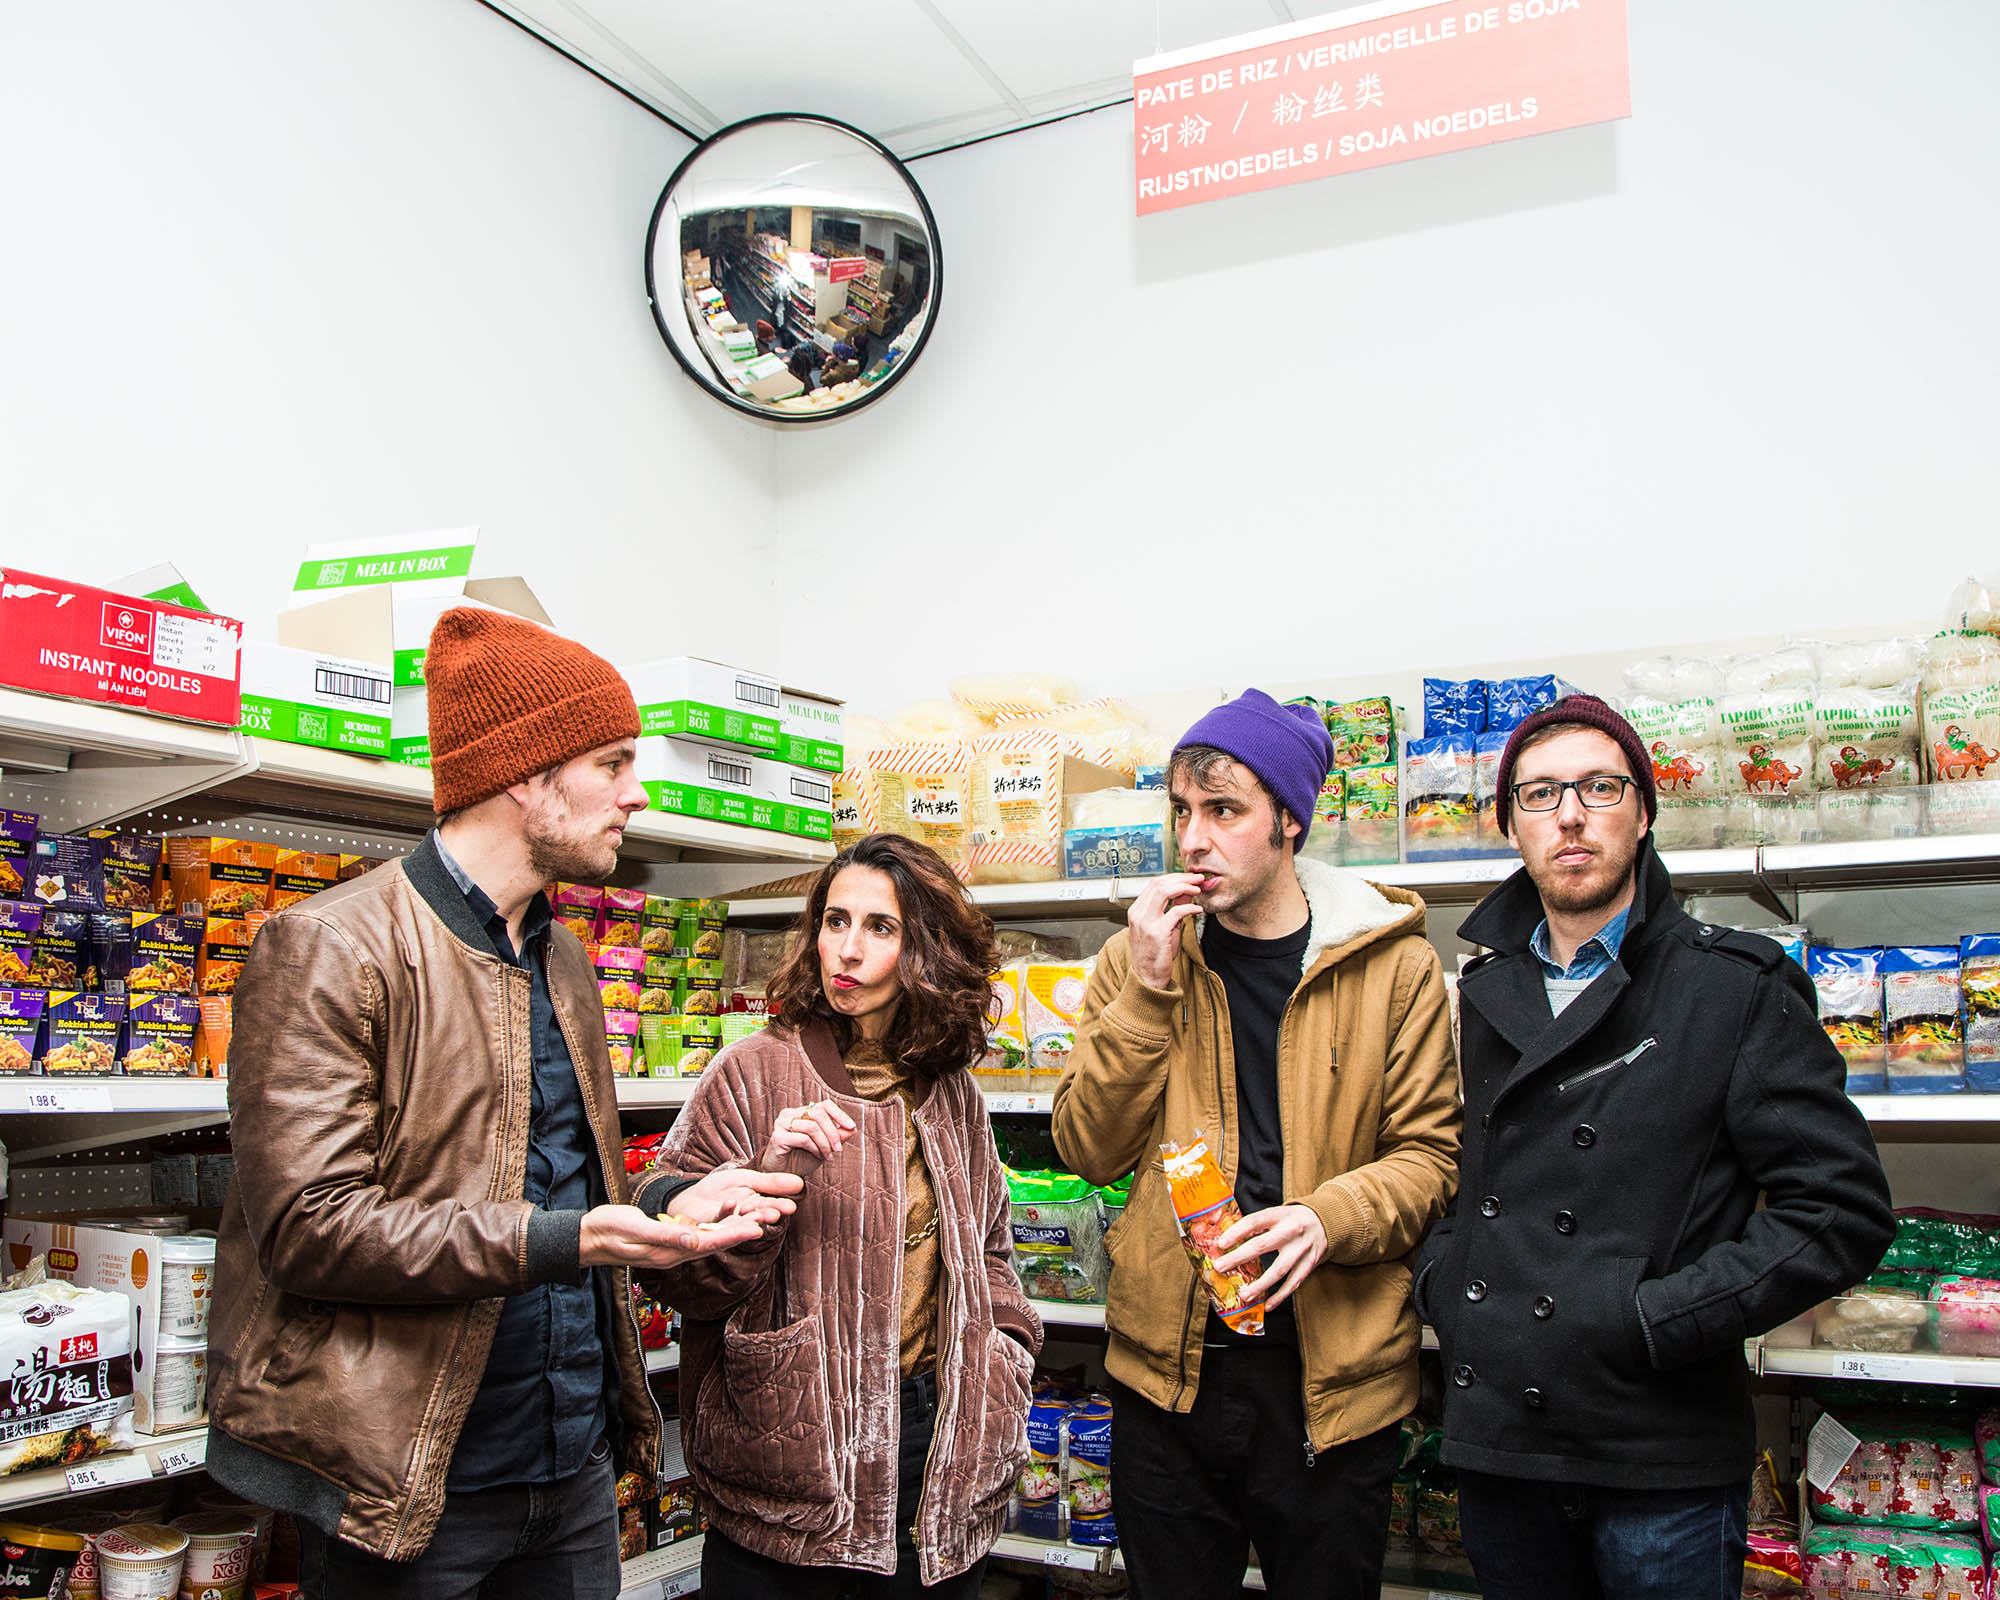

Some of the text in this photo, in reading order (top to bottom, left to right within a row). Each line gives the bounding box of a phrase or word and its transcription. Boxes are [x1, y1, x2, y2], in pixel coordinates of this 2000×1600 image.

[1138, 0, 1580, 109] PATE DE RIZ / VERMICELLE DE SOJA
[1141, 113, 1212, 155] 河粉
[1272, 73, 1384, 126] 粉丝类
[1139, 97, 1538, 199] RIJSTNOEDELS / SOJA NOEDELS
[355, 556, 449, 579] MEAL IN BOX
[105, 626, 146, 645] VIFON
[158, 625, 183, 636] Instan
[39, 648, 202, 694] INSTANT NOODLES
[262, 706, 272, 715] IN
[689, 708, 703, 717] MEAL
[788, 703, 841, 726] MEAL IN BOX
[240, 714, 272, 731] BOX
[344, 720, 382, 736] MICROWAVE
[689, 716, 710, 731] BOX
[339, 731, 385, 749] IN 2 MINUTES
[403, 746, 430, 755] MICROWAV
[994, 775, 1042, 794] 新竹米粉
[1320, 783, 1341, 796] cey
[662, 795, 683, 810] BOX
[911, 797, 958, 815] 新竹米粉
[753, 811, 771, 825] BOX
[0, 840, 20, 848] oodles
[125, 860, 150, 871] Noodles
[3, 930, 26, 938] Noodles
[49, 937, 76, 947] Noodles
[140, 940, 194, 952] Hokkien Noodles
[4, 1017, 28, 1026] Noodles
[58, 1019, 116, 1029] Hokkien Noodles
[138, 1021, 192, 1031] Hokkien Noodles
[29, 1095, 49, 1106] 1.98
[1841, 1361, 1858, 1371] 1.38
[1, 1402, 41, 1419] 非油炸
[1028, 1420, 1049, 1430] ROY-D
[1078, 1433, 1106, 1441] AROY-D
[162, 1452, 189, 1470] 2.05 €
[68, 1470, 97, 1485] 3.85 €
[1046, 1552, 1062, 1563] 1.30
[0, 1563, 31, 1586] oba
